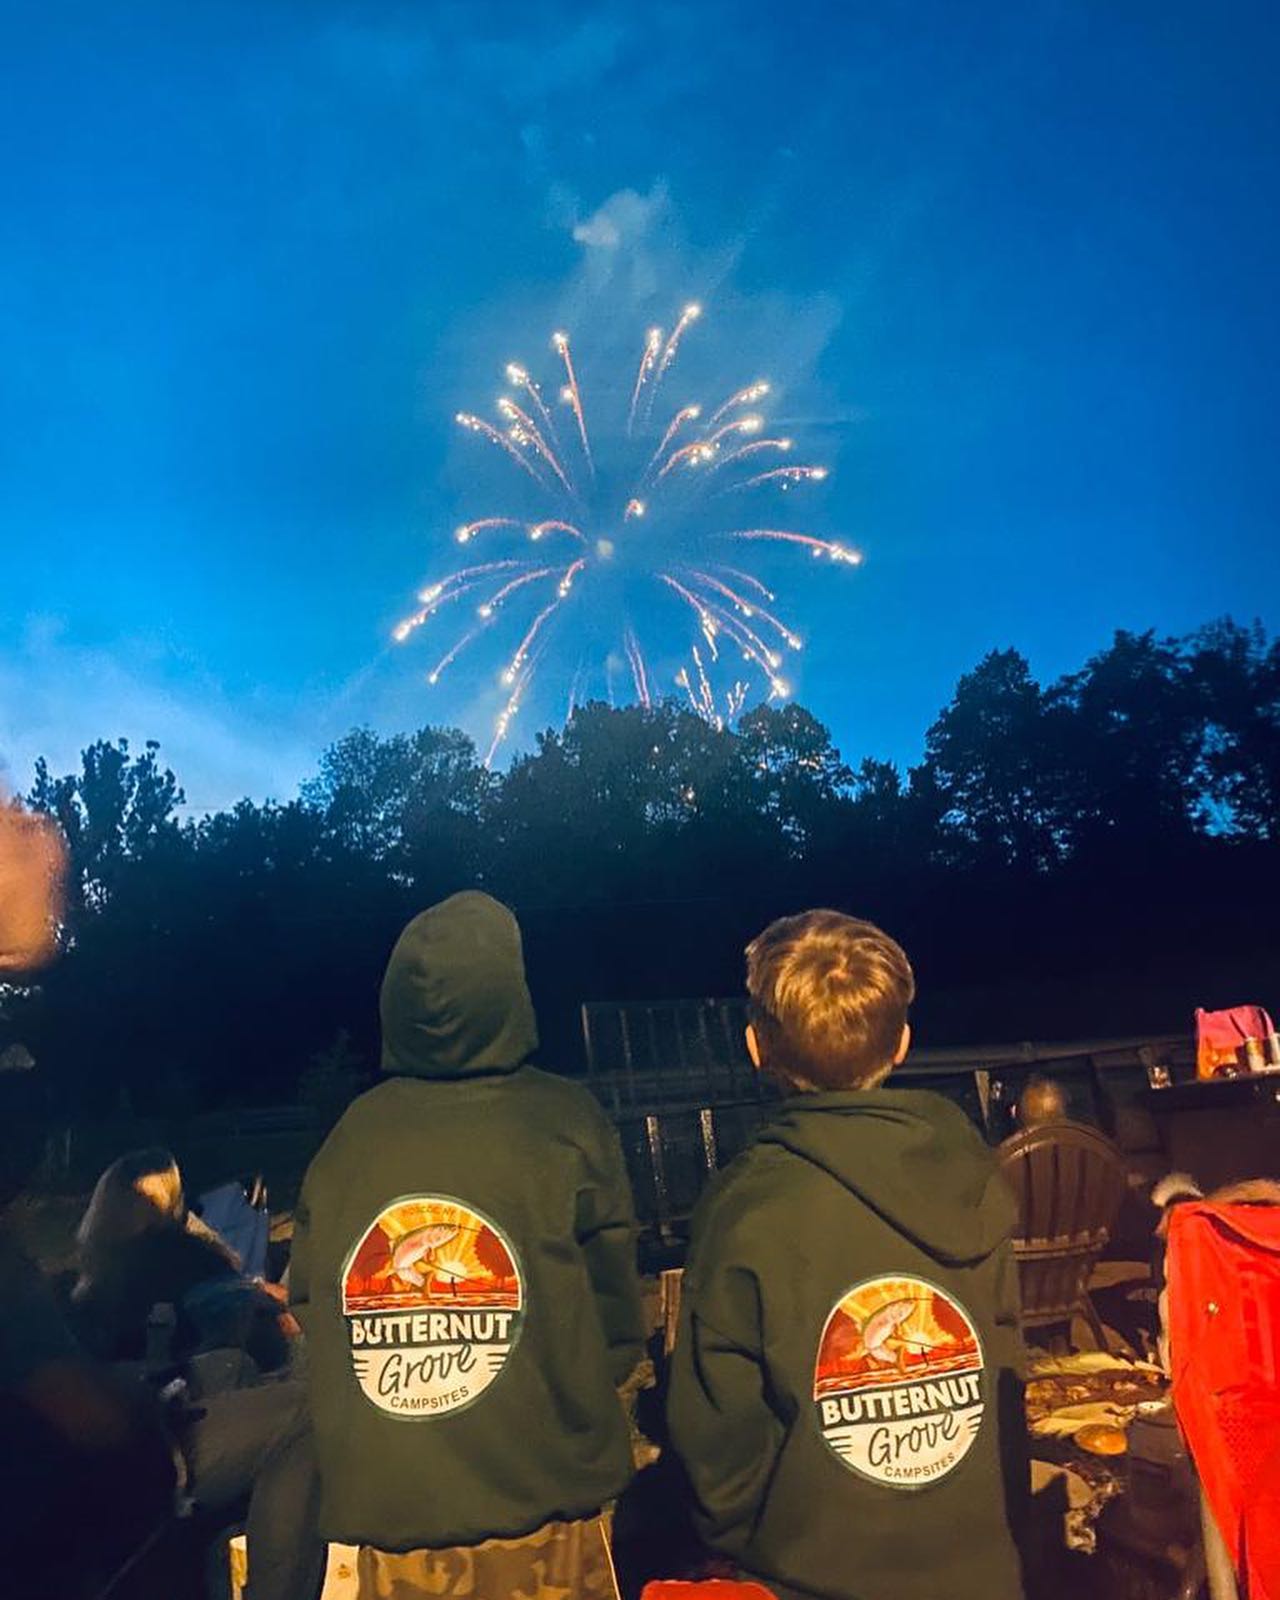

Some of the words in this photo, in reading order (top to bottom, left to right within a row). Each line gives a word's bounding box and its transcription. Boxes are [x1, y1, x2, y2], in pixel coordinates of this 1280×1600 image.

[352, 1313, 512, 1344] BUTTERNUT
[378, 1343, 477, 1396] Grove
[390, 1385, 469, 1409] CAMPSITES
[821, 1374, 980, 1426] BUTTERNUT
[868, 1411, 961, 1467] Grove
[884, 1452, 955, 1479] CAMPSITES
